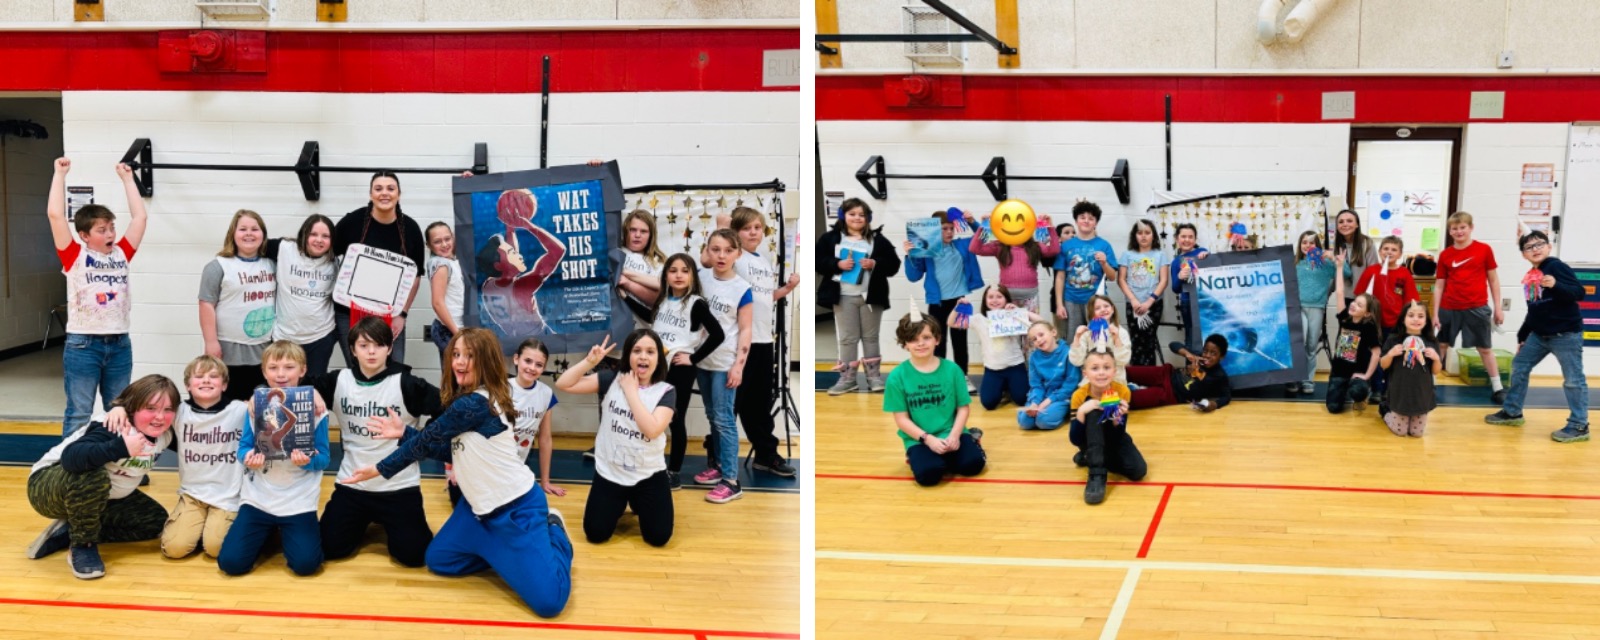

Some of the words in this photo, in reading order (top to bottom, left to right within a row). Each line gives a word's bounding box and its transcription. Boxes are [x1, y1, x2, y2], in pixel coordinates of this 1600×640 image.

[557, 189, 590, 211] WAT
[552, 211, 599, 234] TAKES
[568, 235, 593, 257] HIS
[561, 258, 598, 280] SHOT
[183, 424, 243, 445] Hamilton's
[184, 449, 237, 466] Hoopers
